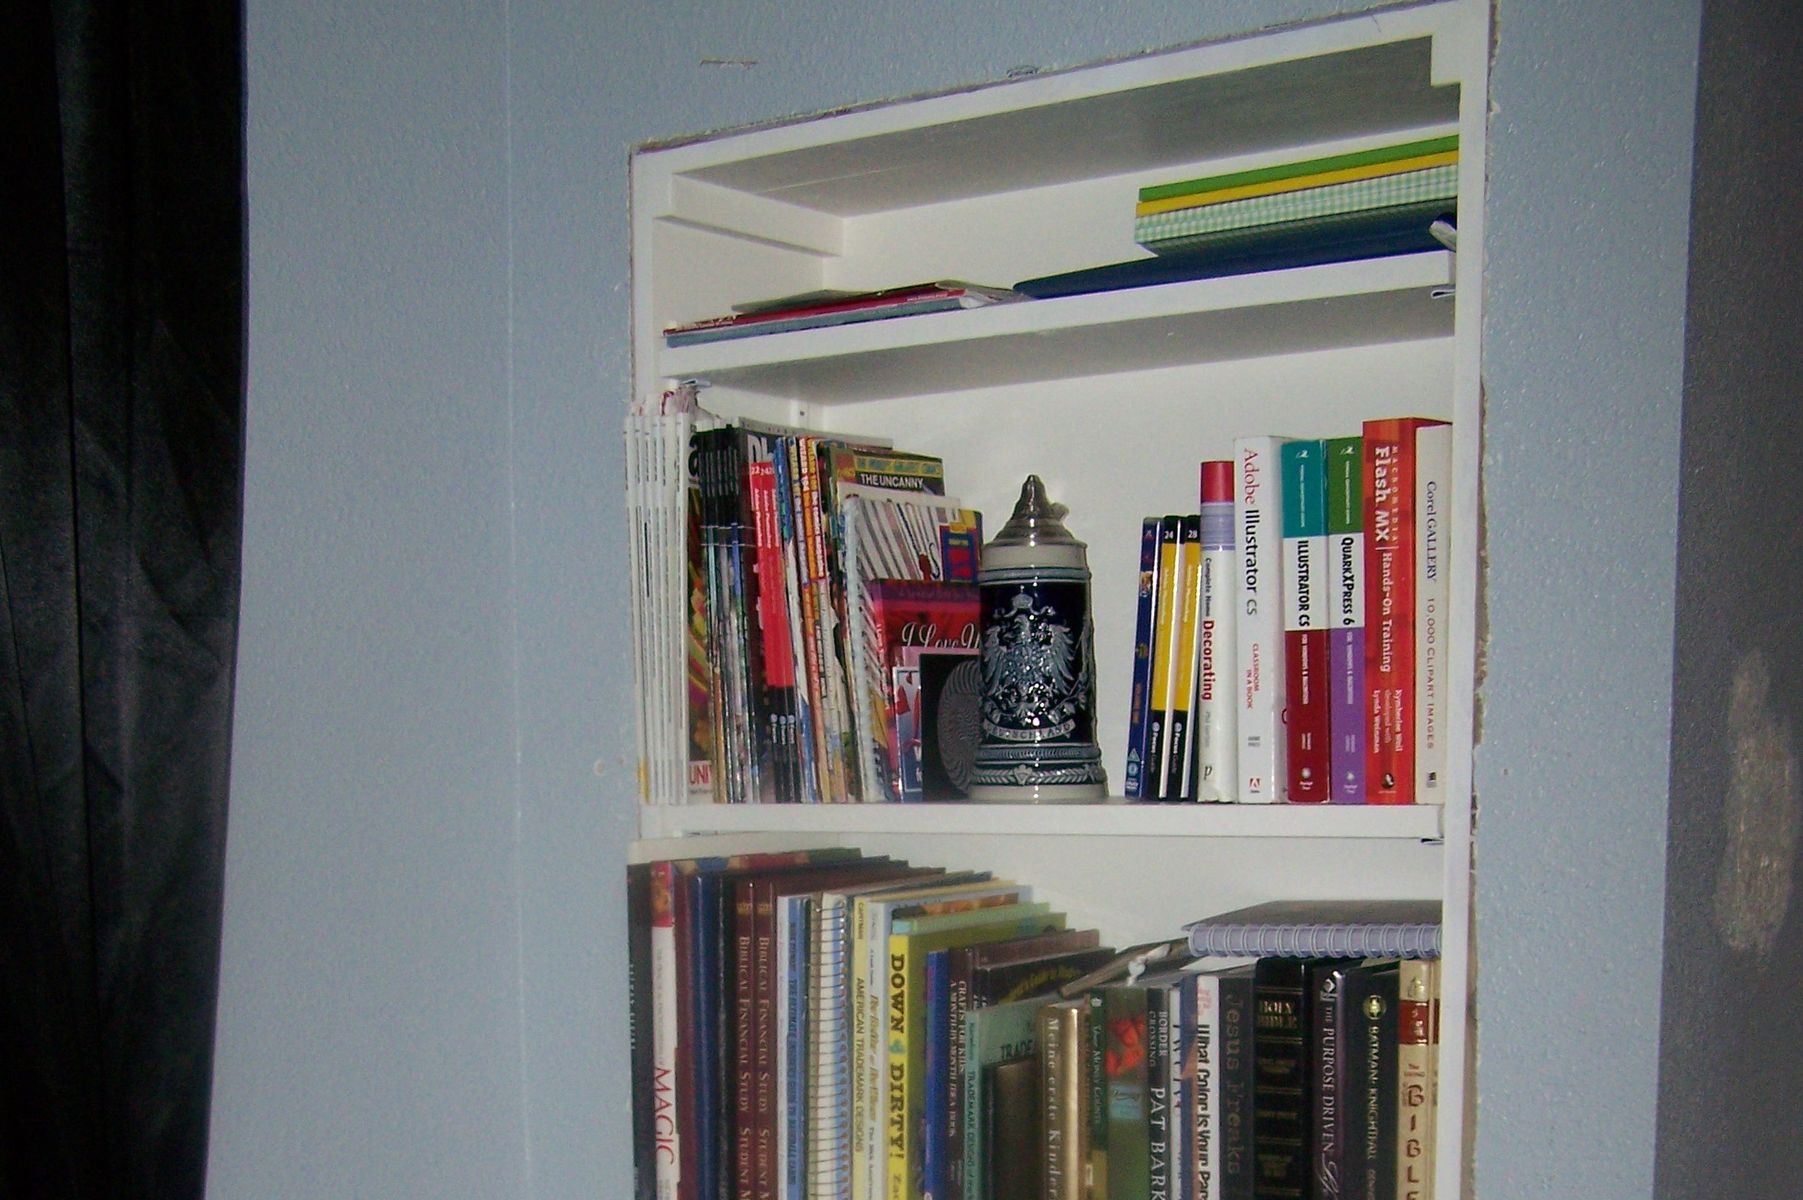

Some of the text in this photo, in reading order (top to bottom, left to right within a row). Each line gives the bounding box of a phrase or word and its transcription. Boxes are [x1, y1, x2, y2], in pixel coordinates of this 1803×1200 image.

[860, 473, 924, 489] THE UNCANNY
[1375, 446, 1390, 541] Flash MX
[1243, 448, 1260, 616] Adobe Illustrator CS
[1426, 481, 1437, 582] Corel GALLERY
[1298, 540, 1311, 627] ILLUSTRATOR CS
[1342, 616, 1354, 626] 6
[1379, 552, 1393, 672] Hands-On Training
[1202, 620, 1215, 701] Decorating
[1252, 643, 1260, 692] CLASSROOM
[1427, 647, 1435, 698] CLIPART
[1246, 687, 1254, 709] BOOK
[1427, 702, 1435, 750] IMAGES
[739, 936, 751, 991] BIBLICAL
[758, 936, 770, 992] BIBLICAL
[739, 998, 751, 1063] FINANCIAL
[758, 999, 770, 1064] FINANCIAL
[1148, 1010, 1157, 1067] CROSSING
[1159, 1010, 1168, 1056] BORDER
[1324, 1006, 1333, 1022] THE
[855, 977, 865, 1153] AMERICAN TRADEMARK DESIGNS
[890, 953, 905, 1159] DOWN DIRTY!
[1047, 1016, 1060, 1069] Meine
[1197, 1023, 1211, 1064] What
[1321, 1027, 1336, 1091] PURPOSE
[739, 1071, 751, 1112] STUDY
[758, 1071, 770, 1112] STUDY
[967, 1071, 975, 1128] TRADEMARK
[1048, 1076, 1060, 1121] erste
[1150, 1087, 1166, 1131] PAT
[1197, 1069, 1211, 1111] Color
[1225, 993, 1244, 1175] Jesus Freaks
[654, 1066, 675, 1165] MAGIC
[1197, 1113, 1211, 1127] Is
[1321, 1095, 1336, 1152] DRIVEN
[1366, 1088, 1379, 1159] KNIGHTFALL
[739, 1126, 751, 1184] STUDENT
[758, 1126, 770, 1186] STUDENT
[1197, 1130, 1211, 1167] Your
